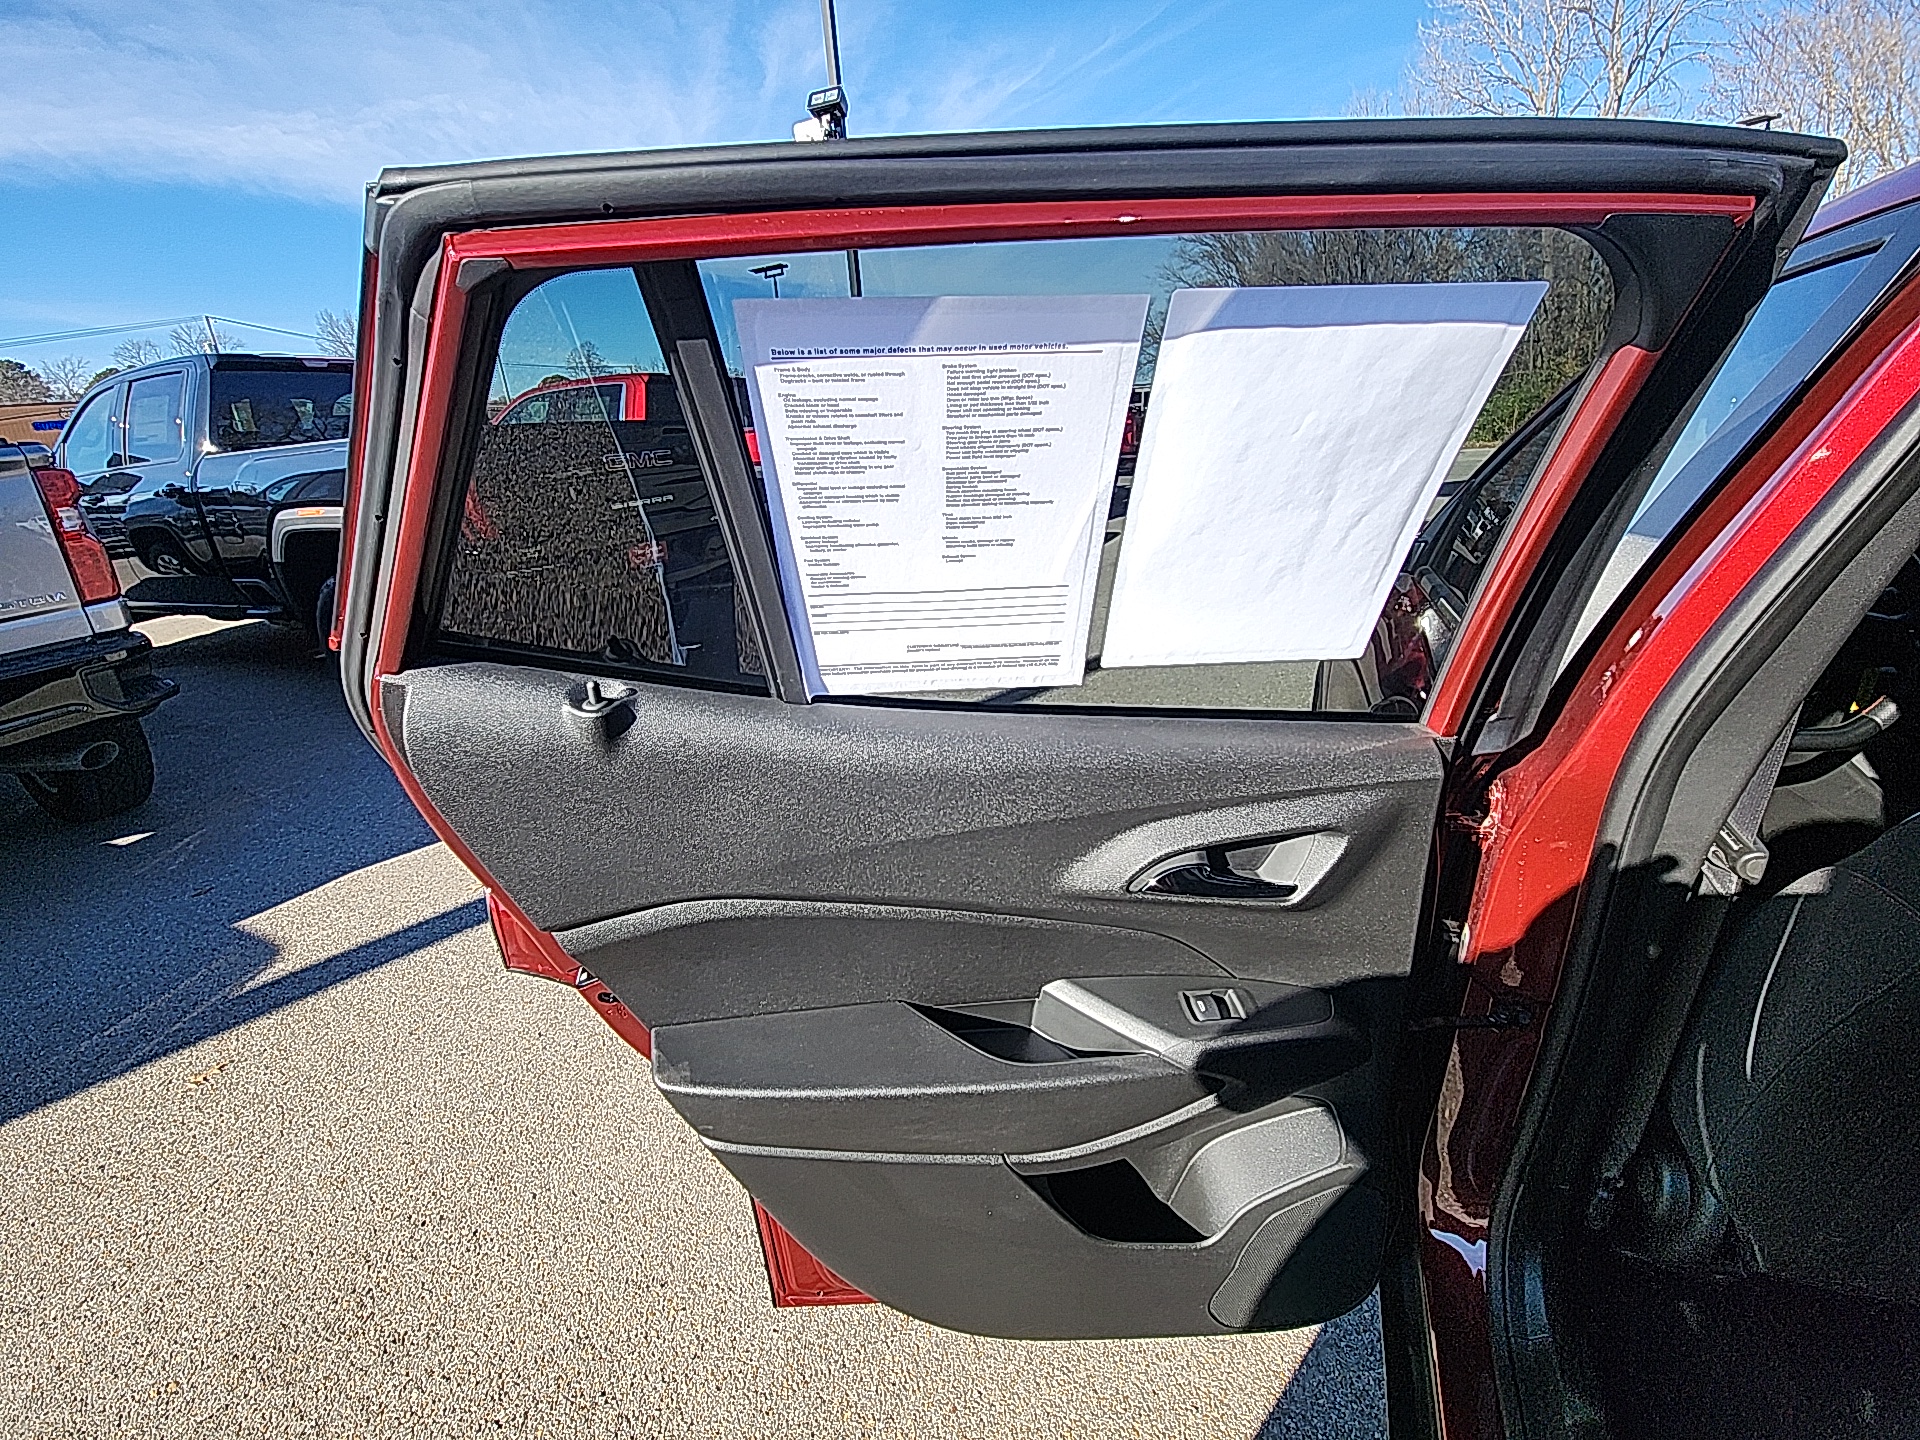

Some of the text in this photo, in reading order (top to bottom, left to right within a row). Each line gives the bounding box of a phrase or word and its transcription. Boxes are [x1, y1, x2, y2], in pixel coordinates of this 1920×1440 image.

[863, 347, 886, 355] major
[603, 449, 673, 471] GMC
[611, 495, 674, 510] SIERRA
